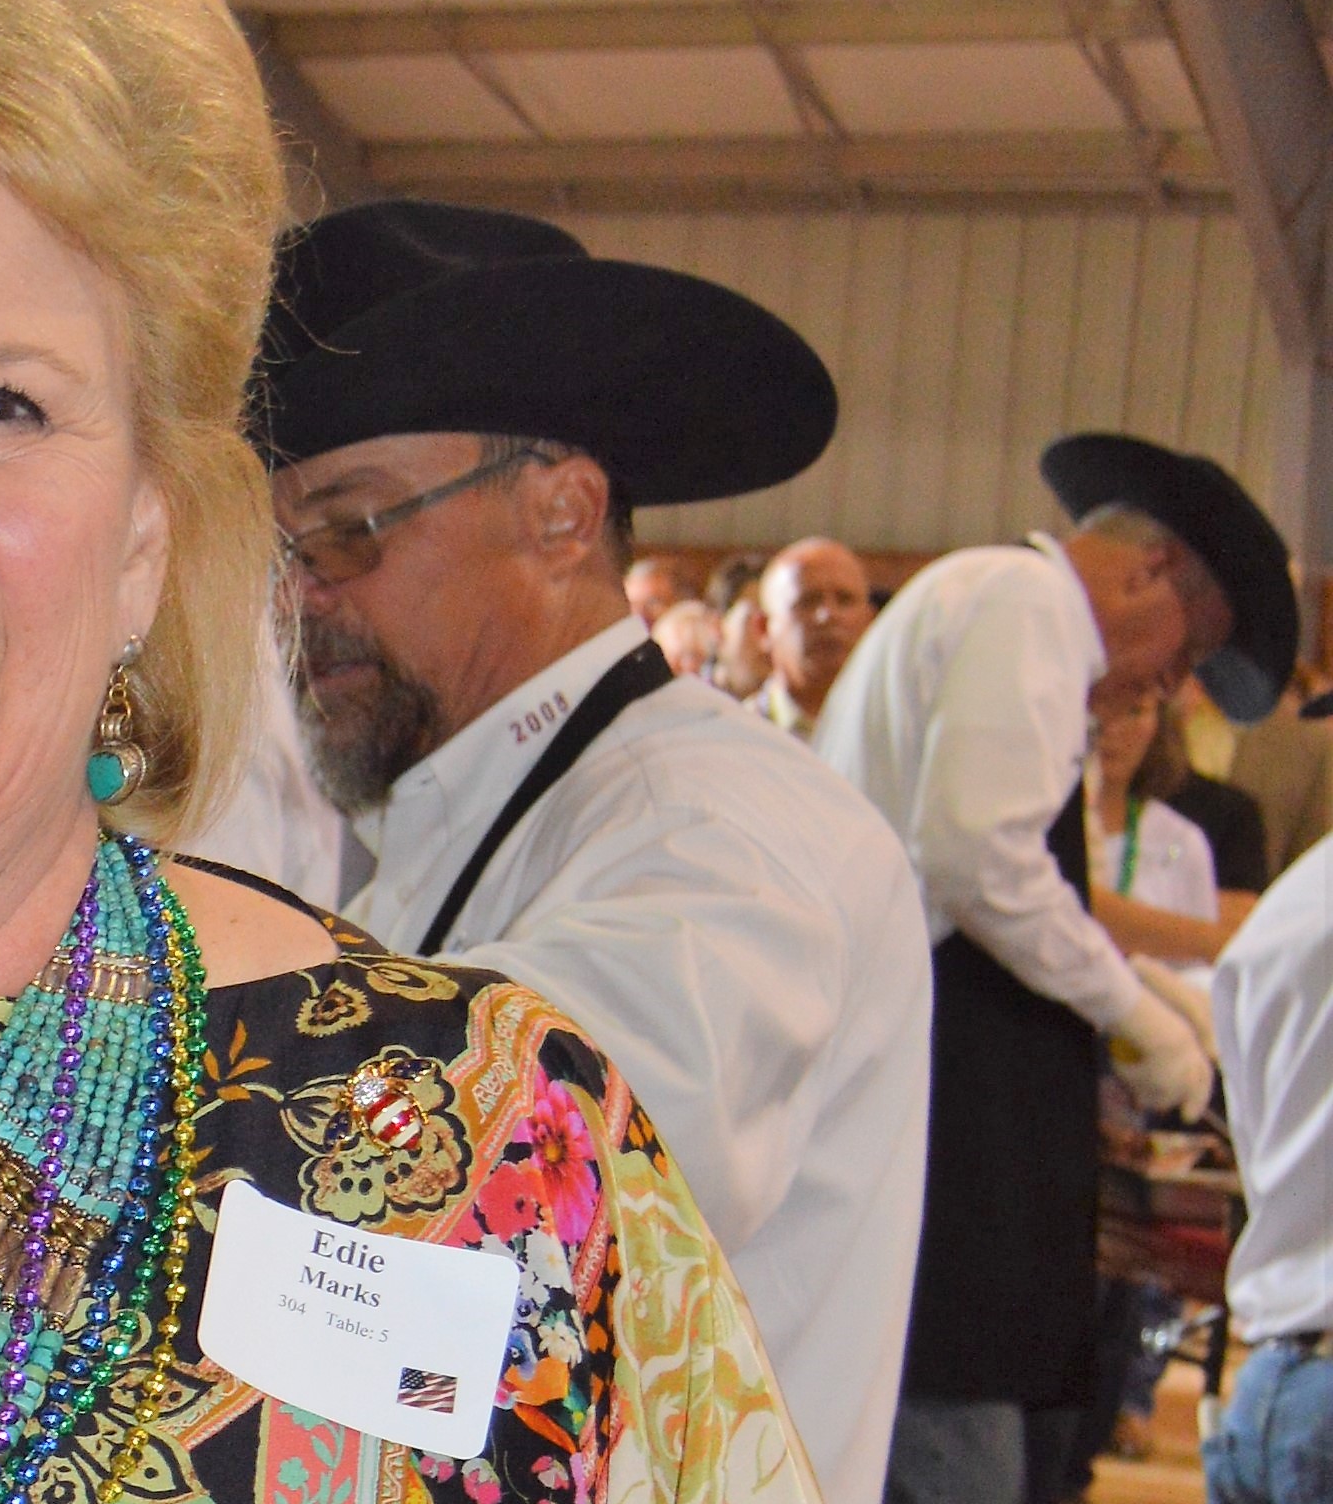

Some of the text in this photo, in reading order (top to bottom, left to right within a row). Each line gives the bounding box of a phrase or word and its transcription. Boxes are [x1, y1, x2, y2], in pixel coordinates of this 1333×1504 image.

[310, 1228, 385, 1273] Edie
[299, 1265, 381, 1307] Marks
[278, 1294, 389, 1343] 304 Table: 5
